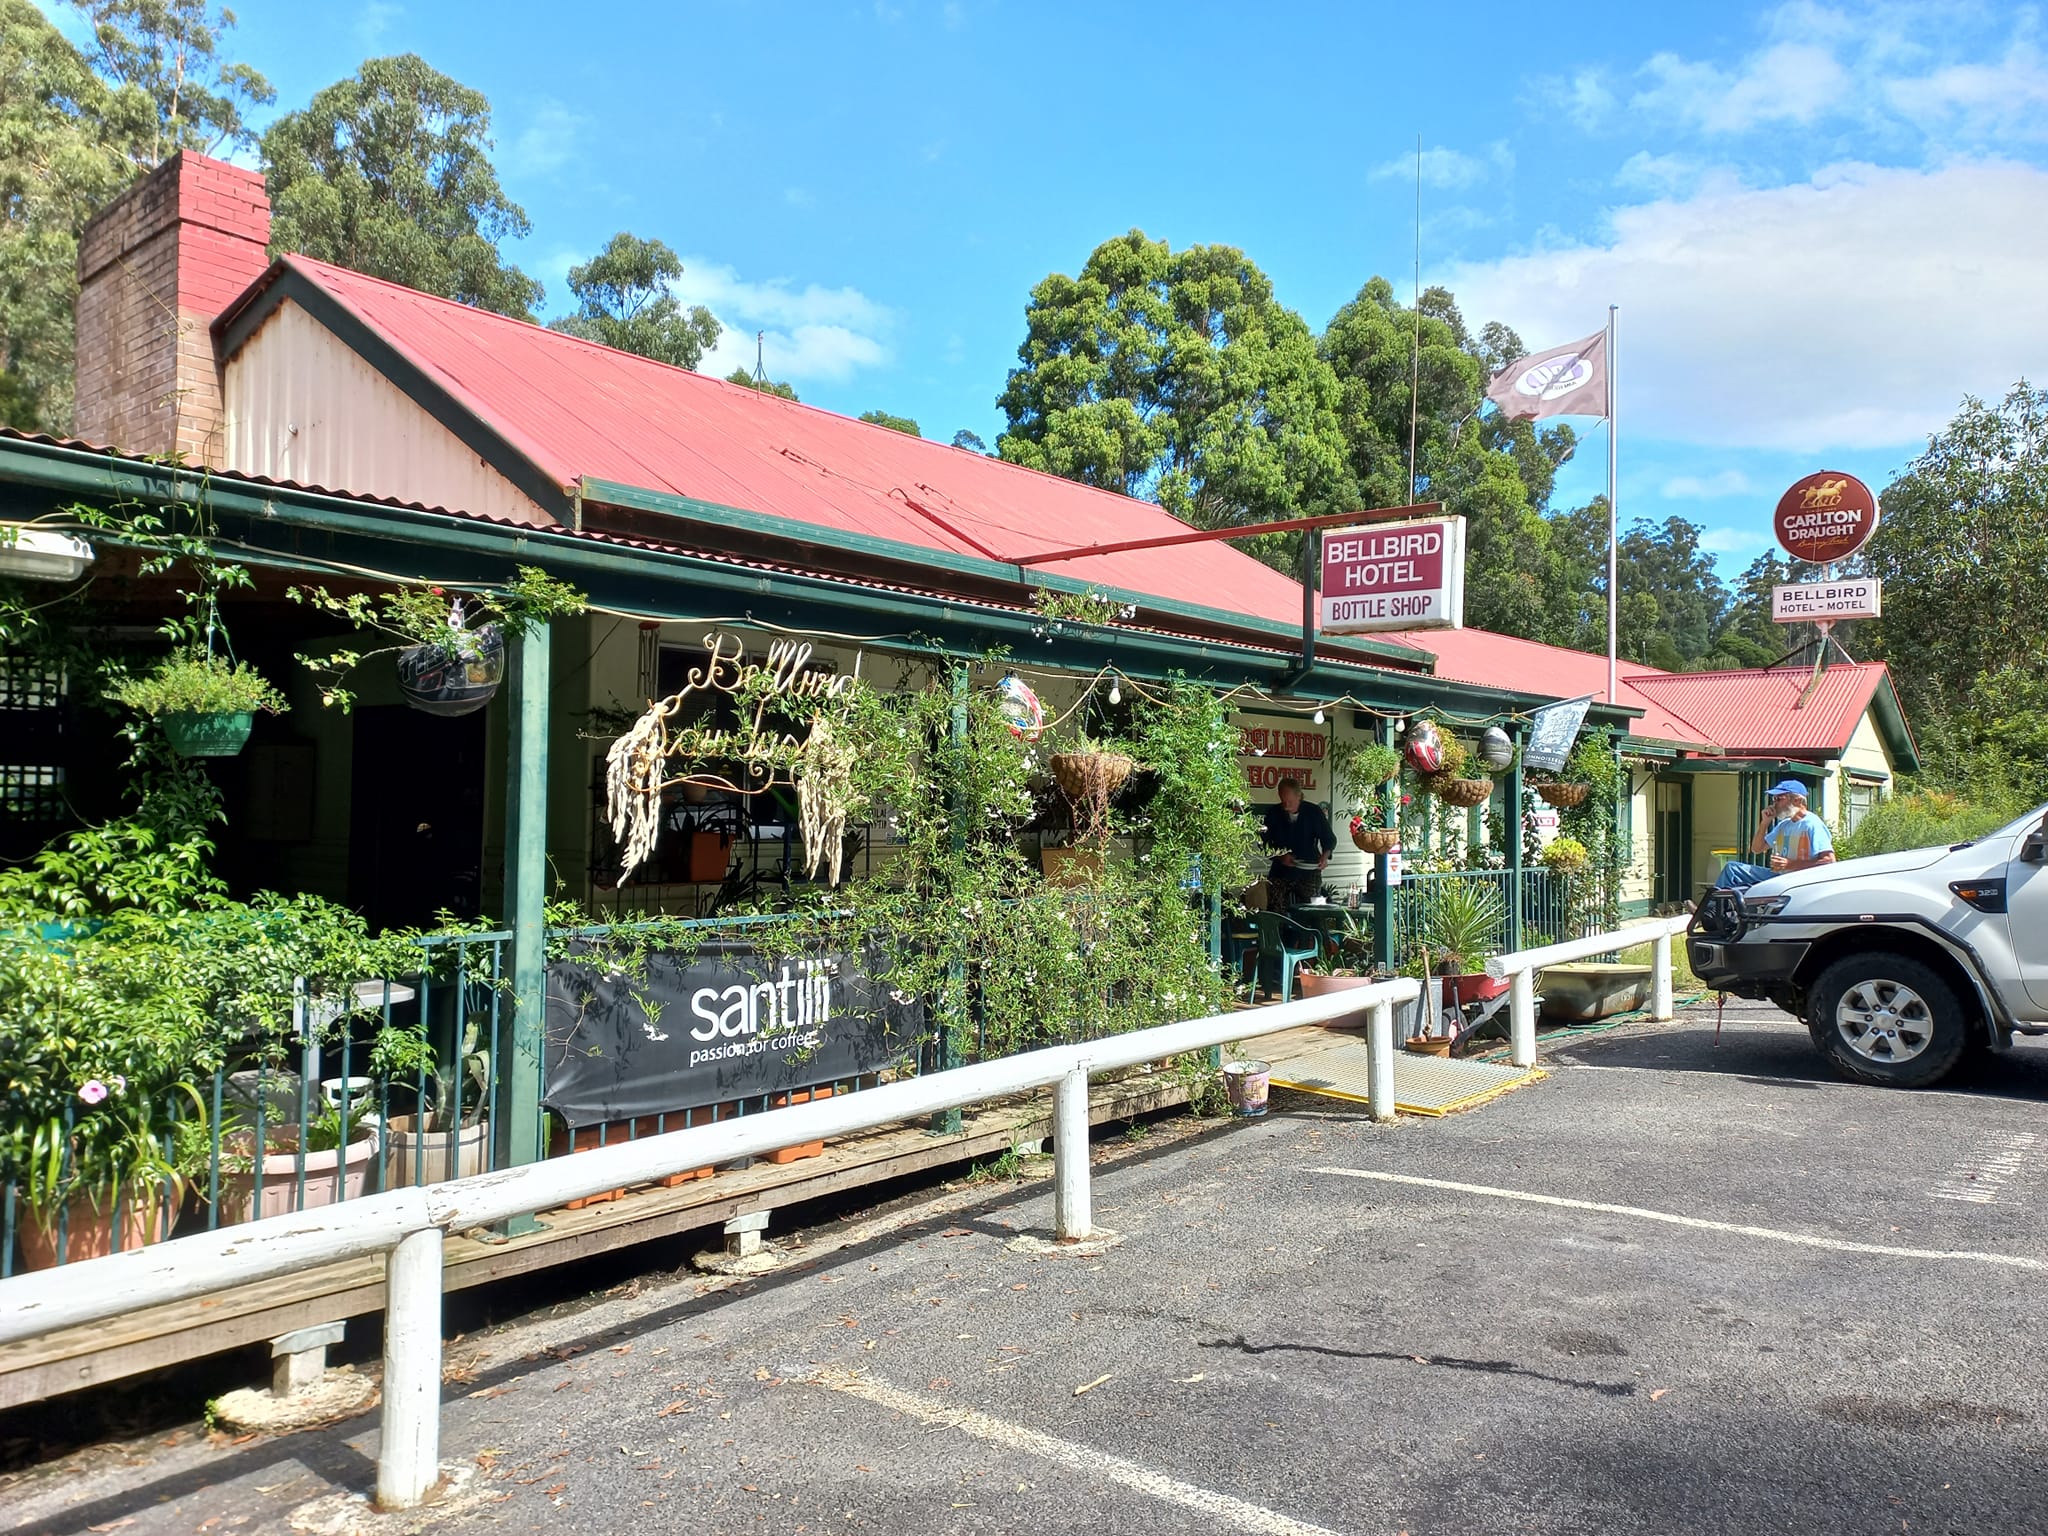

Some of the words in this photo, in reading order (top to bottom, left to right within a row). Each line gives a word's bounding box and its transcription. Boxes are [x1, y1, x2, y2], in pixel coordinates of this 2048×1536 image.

[1783, 509, 1862, 529] CARLTON
[1788, 524, 1856, 541] DRAUGHT
[1328, 533, 1441, 564] BELLBIRD
[1345, 561, 1423, 587] HOTEL
[1783, 587, 1867, 601] BELLBIRD
[1332, 599, 1386, 620] BOTTLE
[1391, 596, 1432, 617] SHOP
[1780, 603, 1815, 613] HOTEL
[1827, 600, 1866, 611] MOTEL
[689, 1041, 745, 1068] passion
